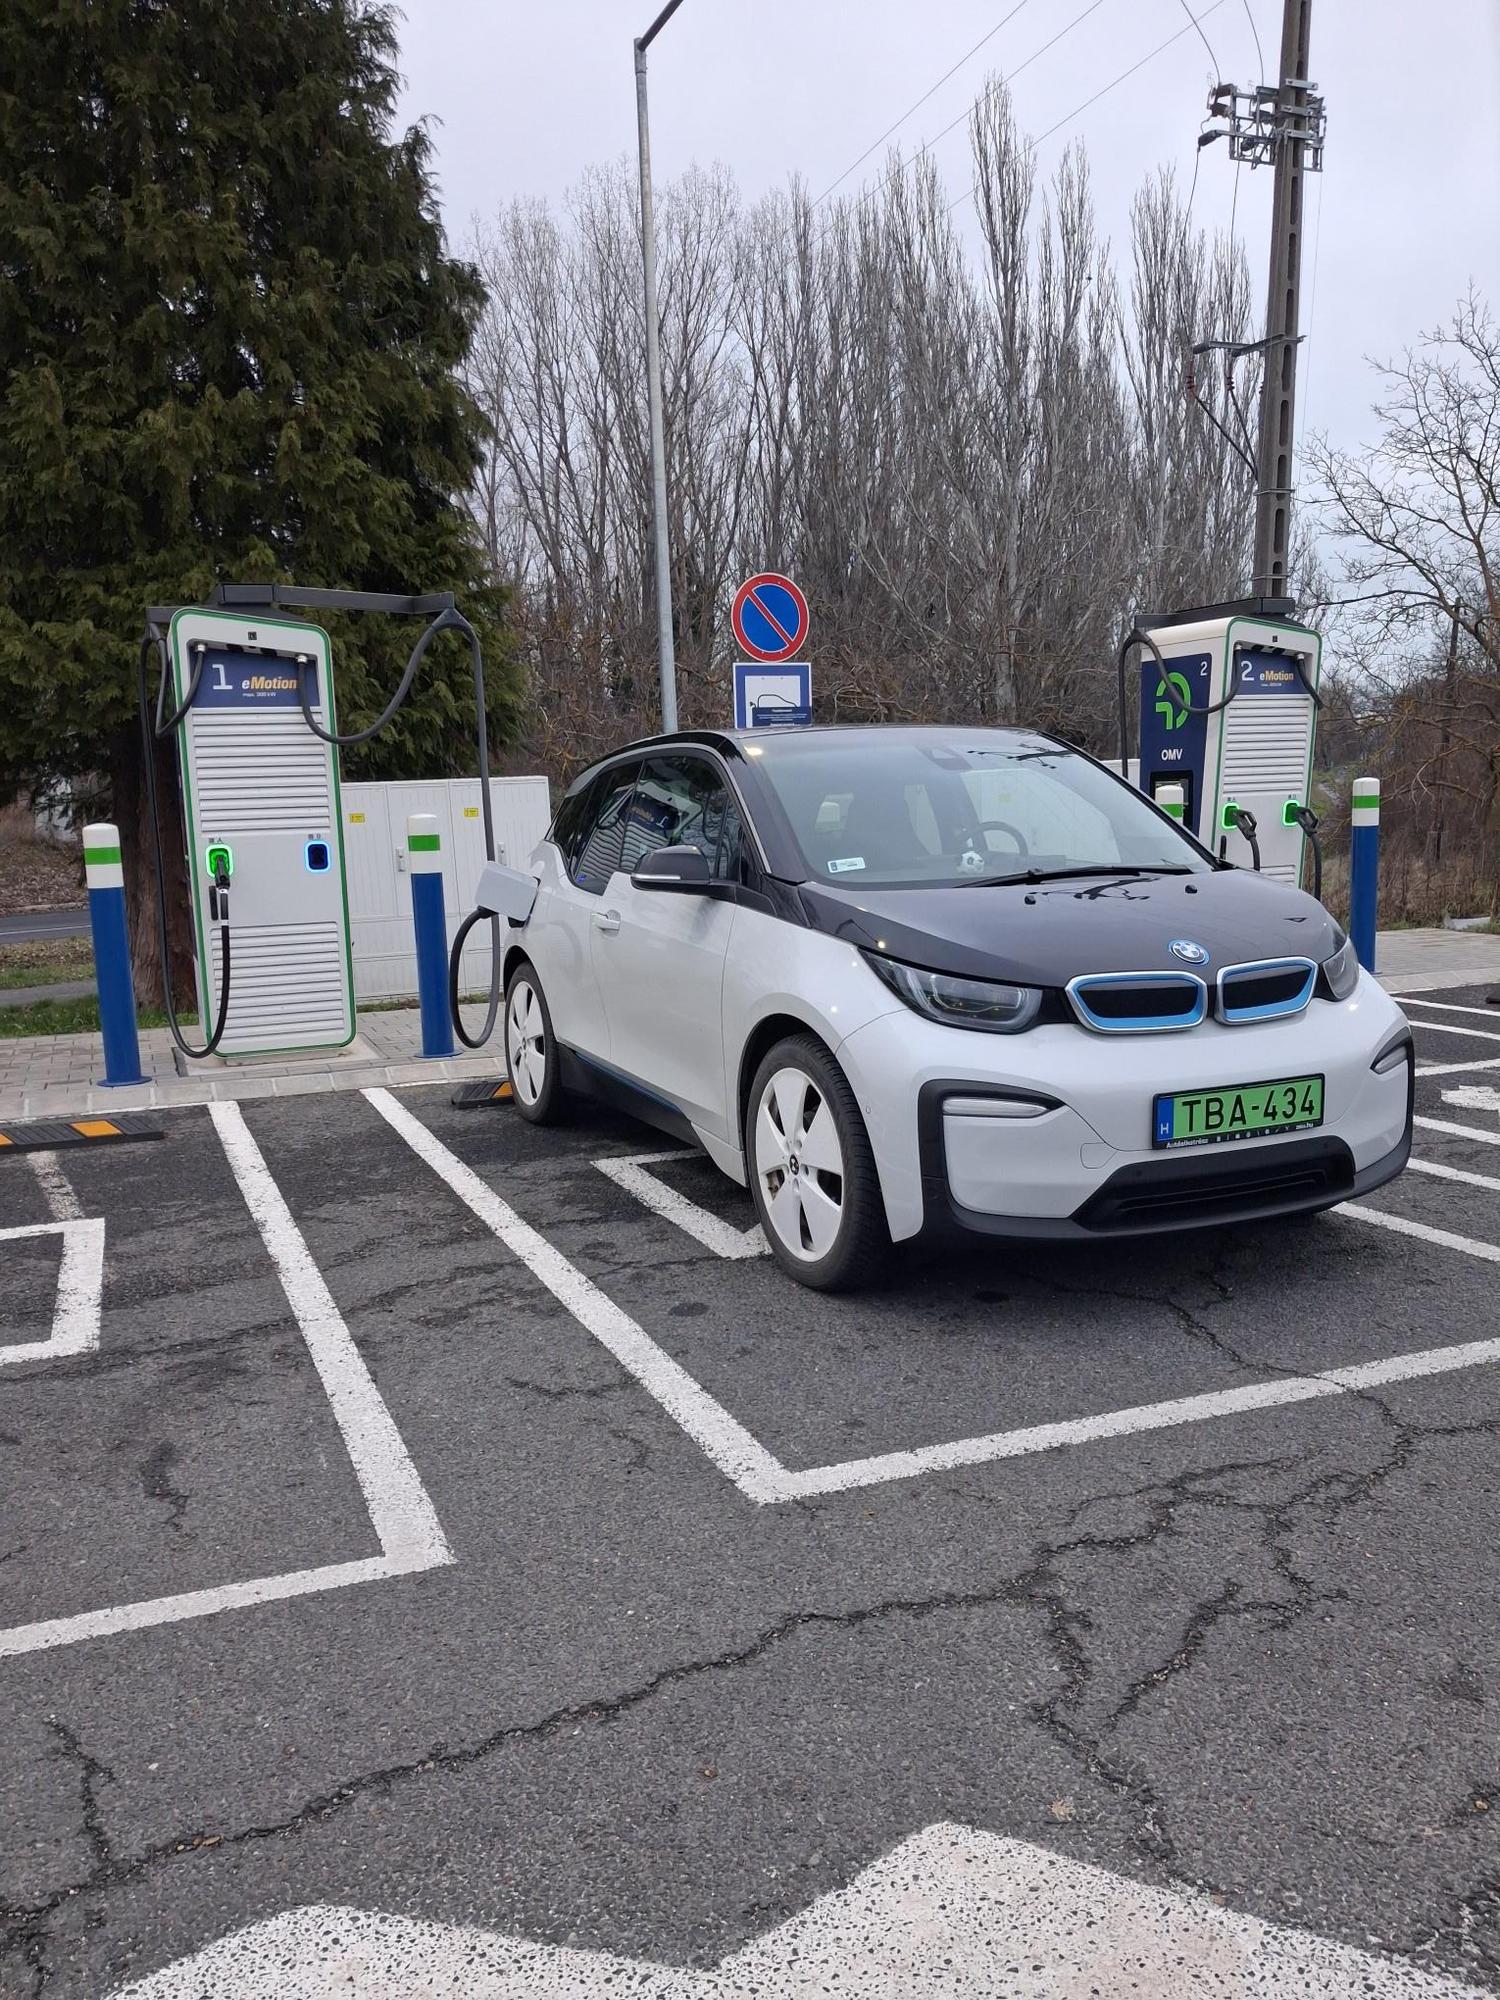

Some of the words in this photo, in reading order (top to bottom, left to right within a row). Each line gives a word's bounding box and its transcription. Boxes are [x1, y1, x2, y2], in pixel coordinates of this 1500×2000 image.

[1199, 661, 1208, 676] 2
[1240, 660, 1254, 681] 2
[212, 664, 233, 690] 1
[241, 676, 297, 690] eMotion
[1259, 670, 1294, 682] eMotion
[1161, 748, 1183, 761] OMV
[1182, 1084, 1315, 1132] TBA-434
[1160, 1122, 1169, 1135] H
